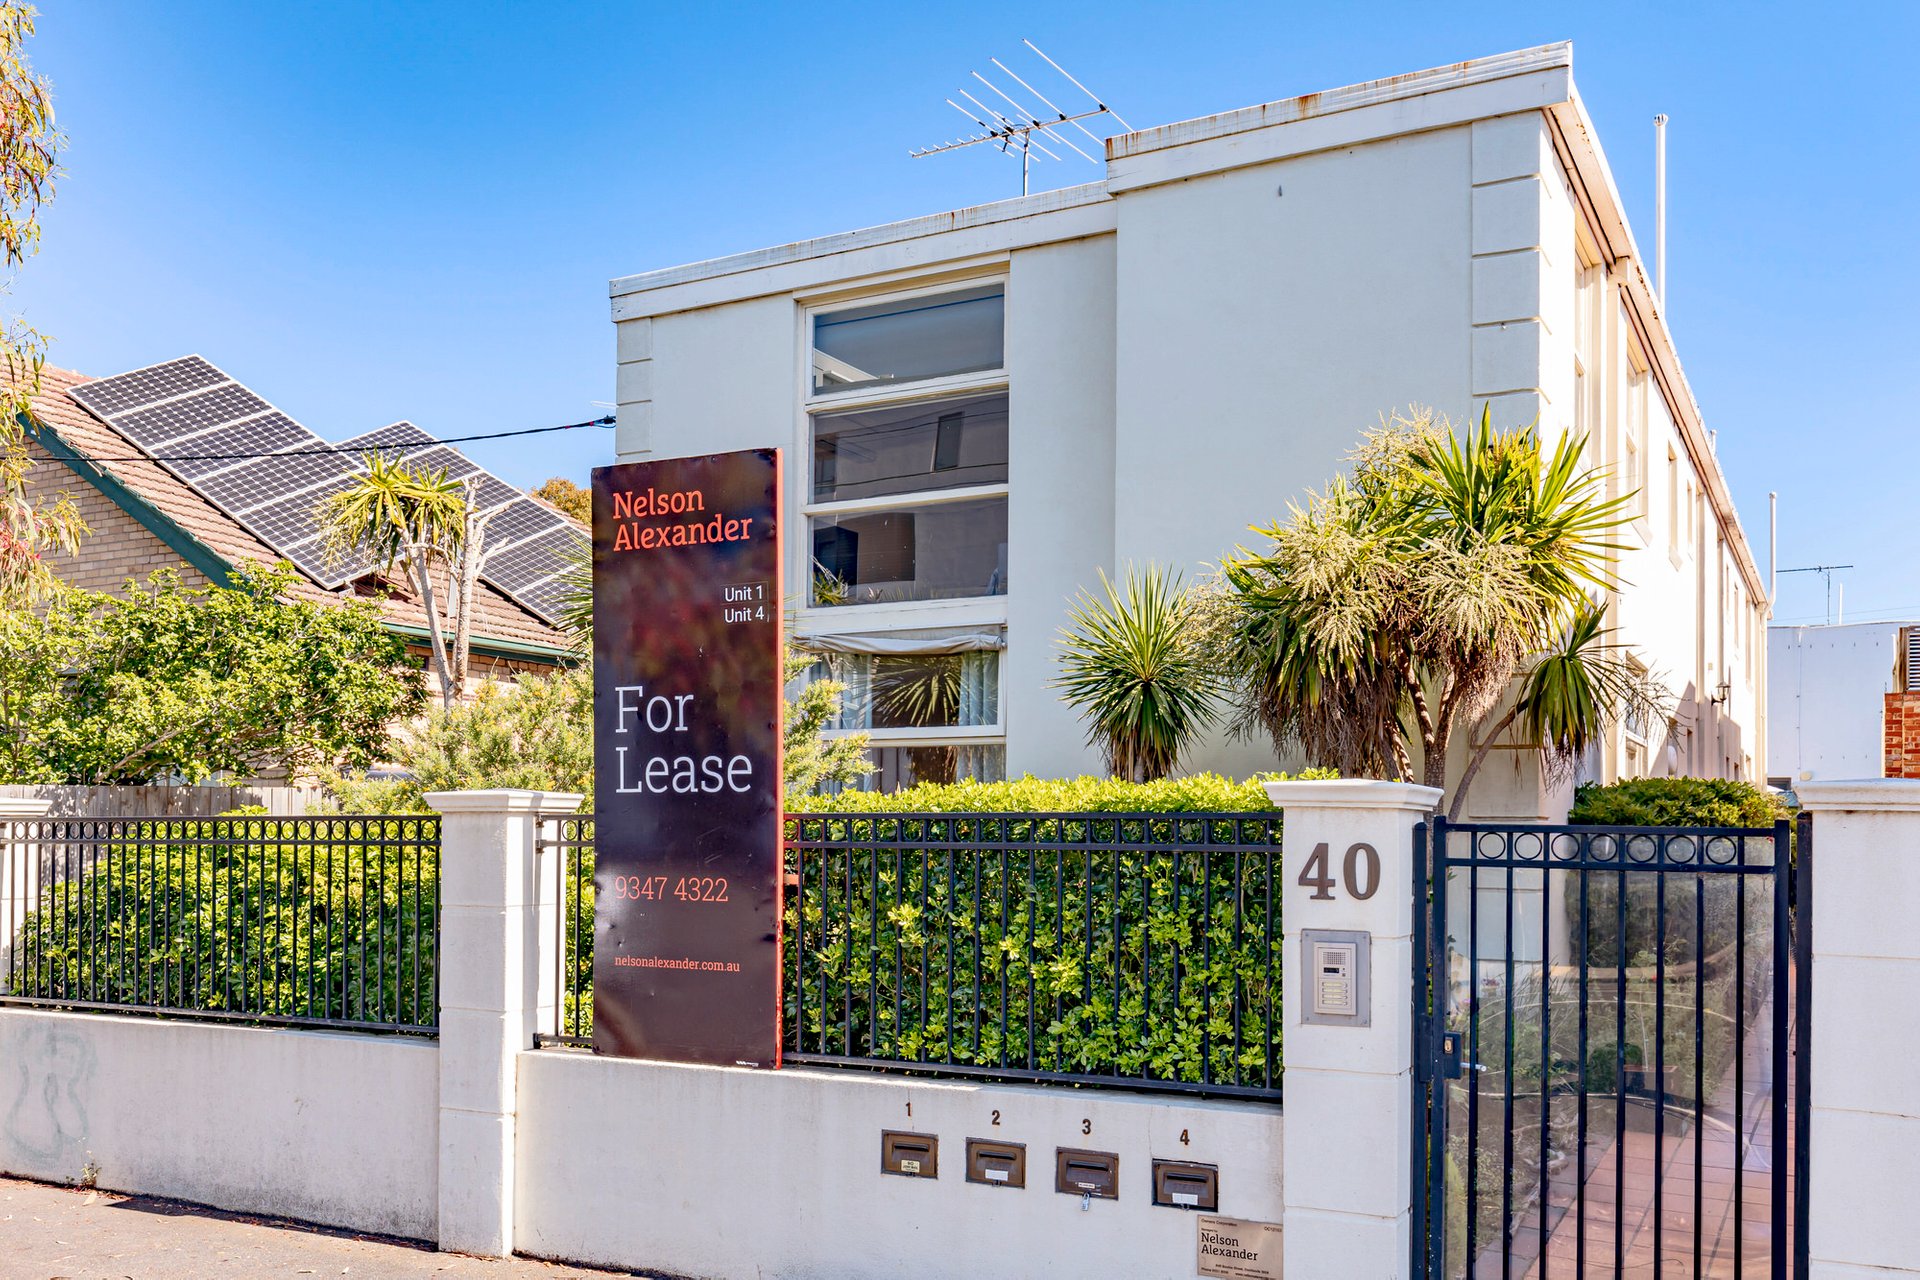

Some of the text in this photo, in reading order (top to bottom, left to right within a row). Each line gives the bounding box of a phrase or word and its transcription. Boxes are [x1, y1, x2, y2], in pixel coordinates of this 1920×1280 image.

[612, 487, 705, 520] Nelson
[613, 513, 753, 552] Alexander
[724, 585, 763, 602] Unit 1
[724, 606, 765, 623] Unit 4
[615, 685, 694, 733] For
[615, 746, 752, 793] Lease
[1298, 842, 1381, 901] 40
[614, 875, 729, 902] 9347 4322
[614, 954, 741, 973] nelsonalexander.com.au
[905, 1101, 912, 1117] 1
[991, 1109, 1001, 1126] 2
[1081, 1118, 1092, 1135] 3
[1179, 1128, 1190, 1146] 4
[1200, 1232, 1239, 1247] Nelson
[1200, 1244, 1258, 1261] Alexander
